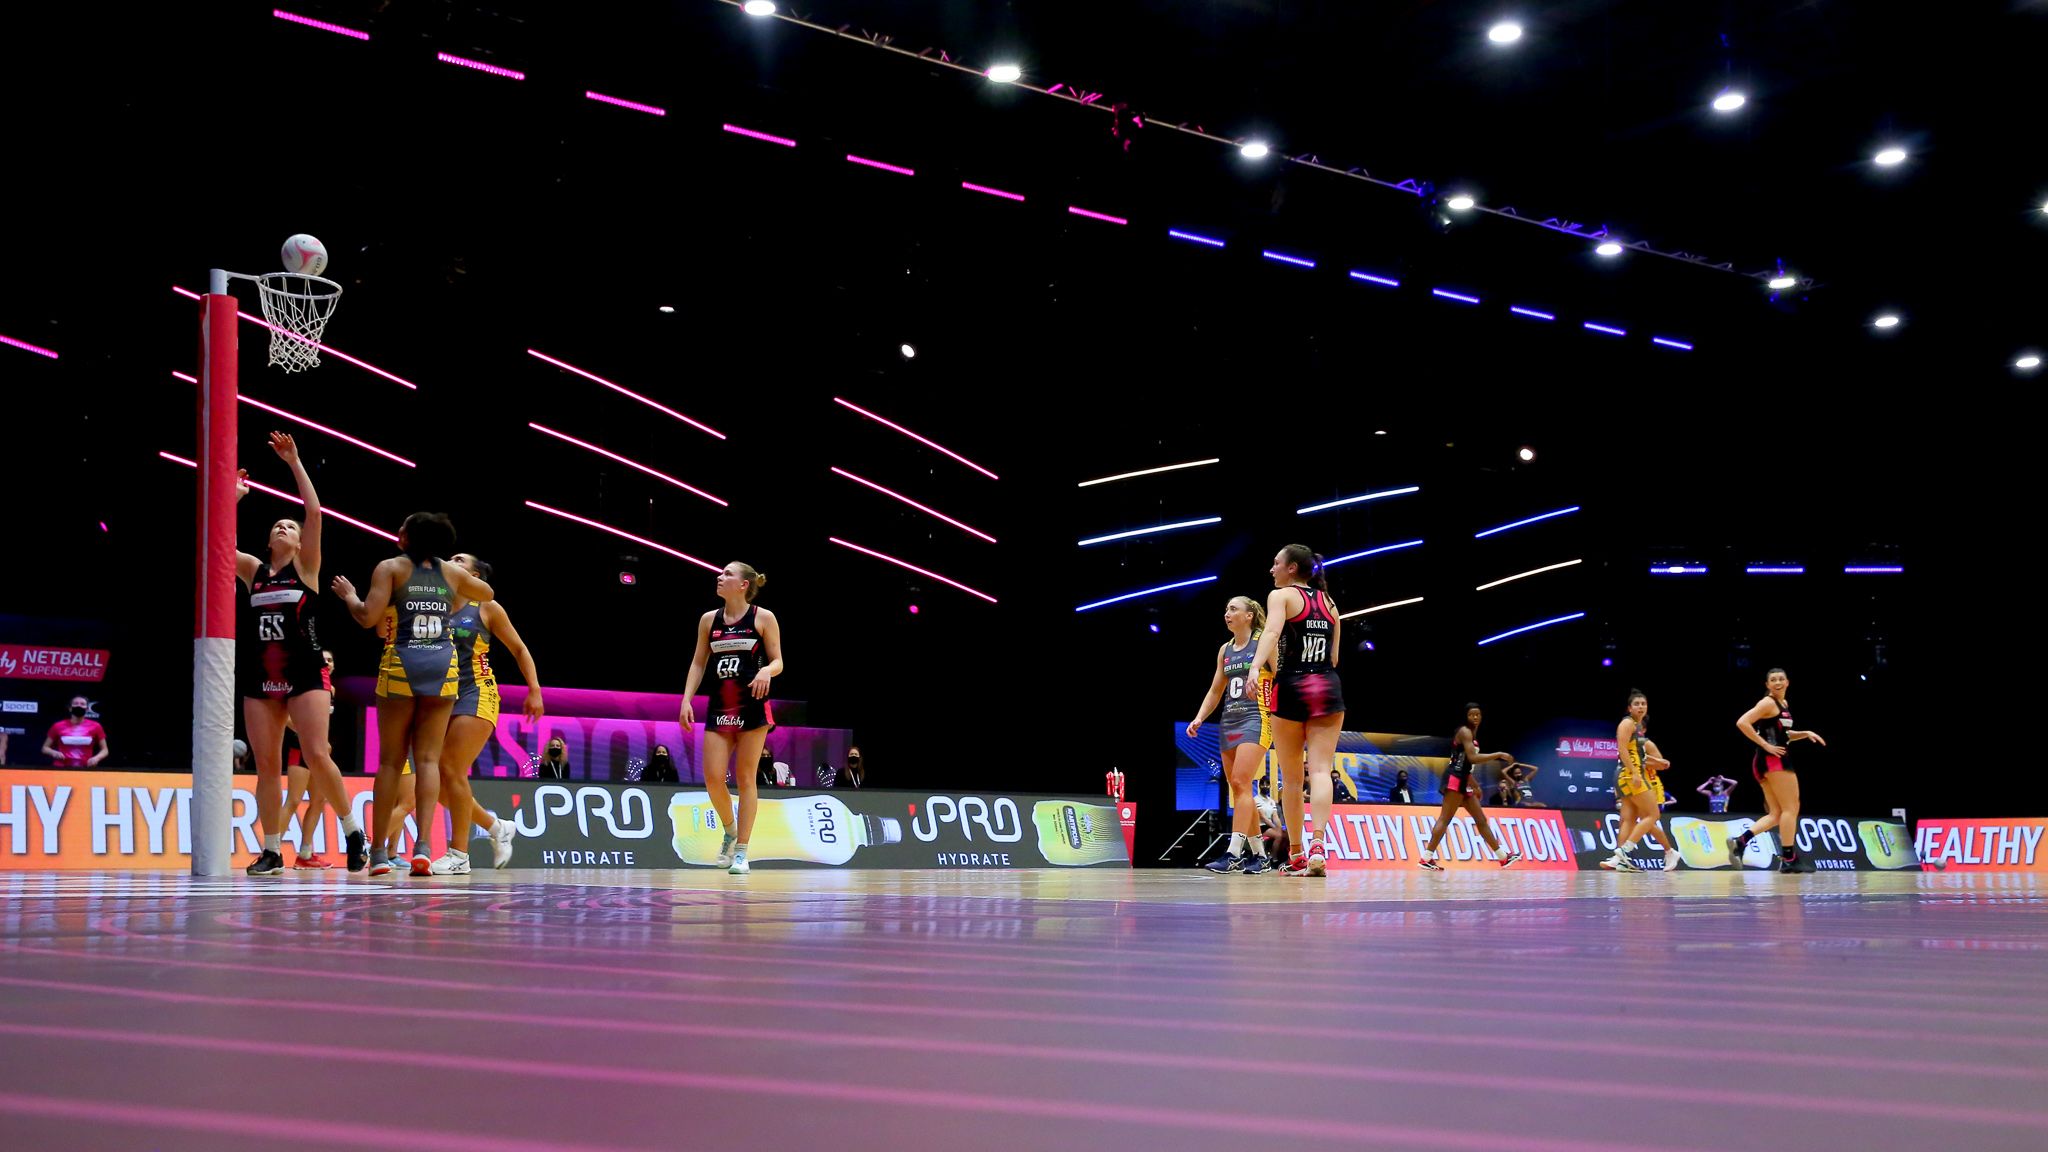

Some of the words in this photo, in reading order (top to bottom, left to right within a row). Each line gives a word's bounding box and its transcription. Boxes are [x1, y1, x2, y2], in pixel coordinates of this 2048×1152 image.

[406, 601, 447, 612] OYESOLA
[259, 614, 285, 641] GS
[412, 614, 443, 639] GD
[1306, 619, 1328, 629] DEKKER
[1301, 636, 1327, 662] WA
[23, 649, 104, 667] NETBALL
[22, 664, 100, 677] SUPERLEAGUE
[262, 681, 293, 693] Vitality
[1229, 677, 1243, 699] C
[716, 714, 745, 728] Vitality
[1594, 741, 1618, 751] NETBAL
[1302, 813, 1408, 860] EALTHY
[543, 850, 635, 865] HYDRATE
[938, 853, 1011, 866] HYDRATE
[1814, 859, 1856, 870] HYDRATE
